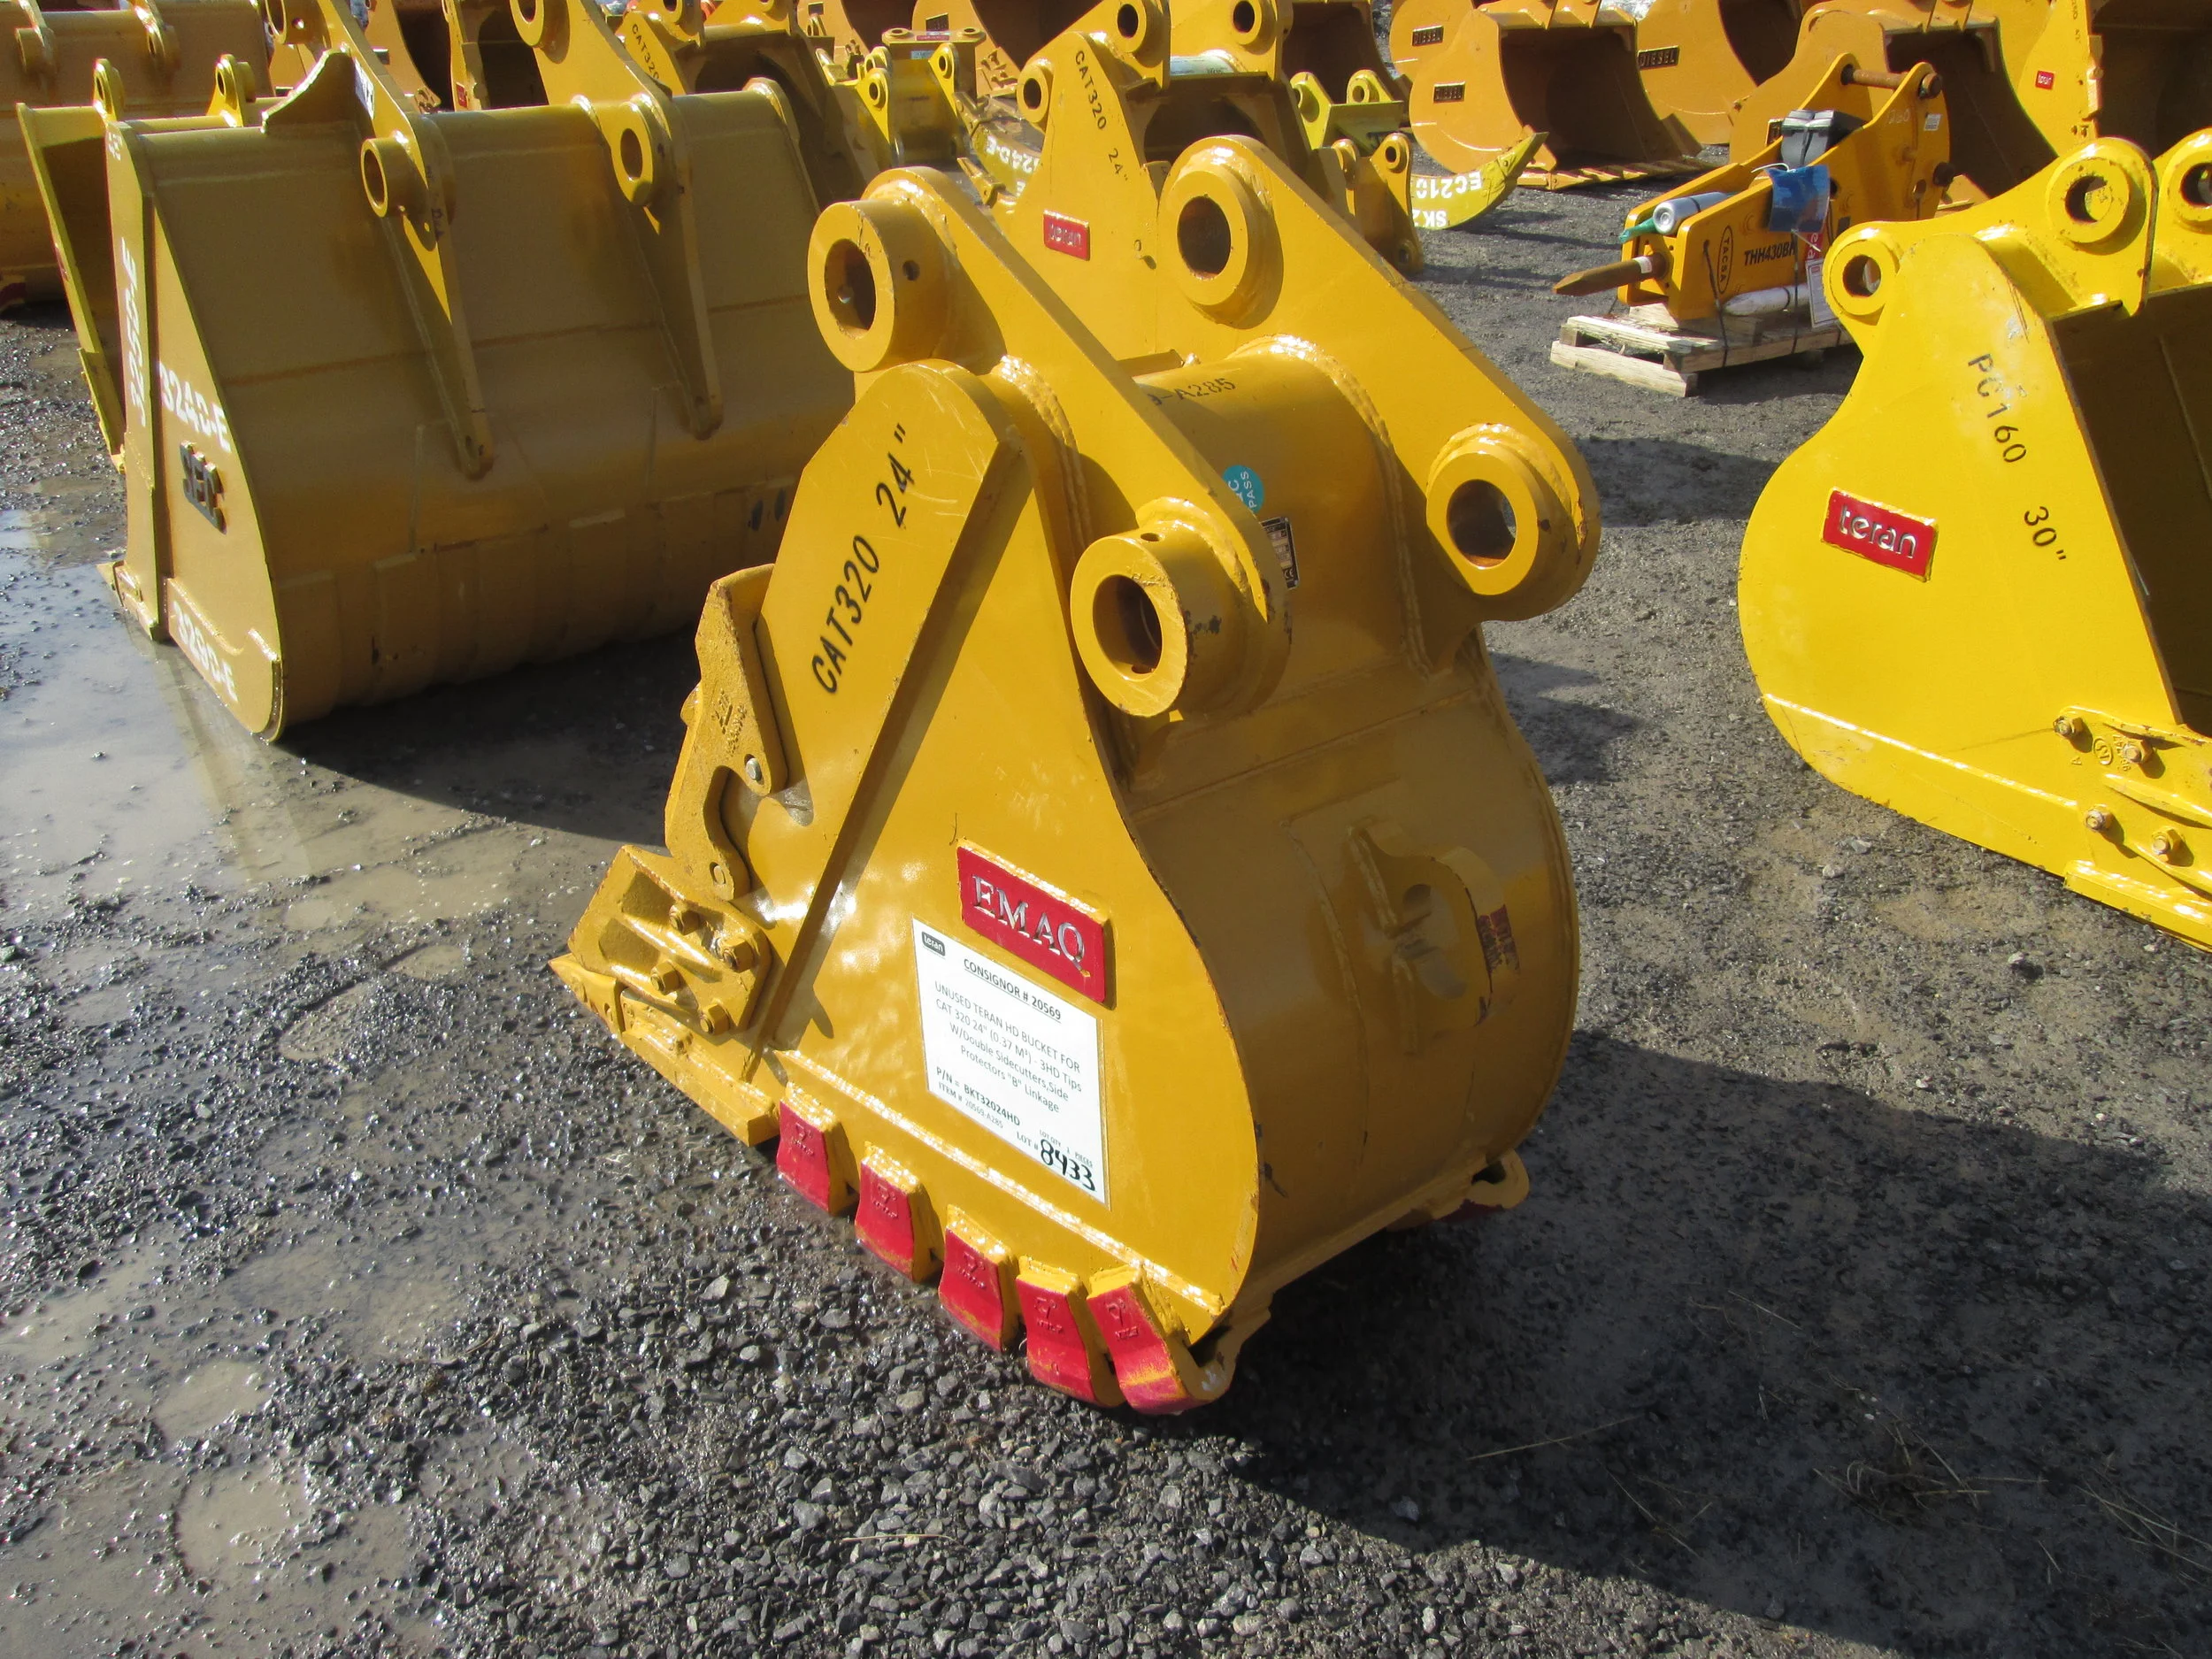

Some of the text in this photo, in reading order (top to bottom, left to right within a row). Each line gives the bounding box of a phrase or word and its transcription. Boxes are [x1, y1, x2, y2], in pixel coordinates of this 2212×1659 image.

[1075, 50, 1128, 180] CAT320 24"
[1968, 353, 2067, 560] PC160 30"
[1240, 471, 1257, 509] PASS
[811, 422, 915, 695] CAT320 24"
[1839, 504, 1916, 559] teran
[923, 932, 944, 953] teran
[972, 874, 1091, 978] EMAQ
[964, 958, 1020, 998] CONSIGNOR
[1032, 996, 1061, 1020] 20569
[935, 980, 1080, 1073] UNUSED TERAN HD BUCKET FOR
[936, 999, 952, 1015] CAT
[956, 1009, 970, 1025] 320
[1041, 1059, 1060, 1078] 3HD
[1063, 1072, 1081, 1092] Tips
[949, 1022, 994, 1056] W/Double
[936, 1066, 952, 1083] P/N
[964, 1084, 1020, 1126] BKT32024HD
[961, 1045, 1005, 1079] Protectors
[1025, 1084, 1059, 1112] Linkage
[1041, 1139, 1095, 1191] 8433
